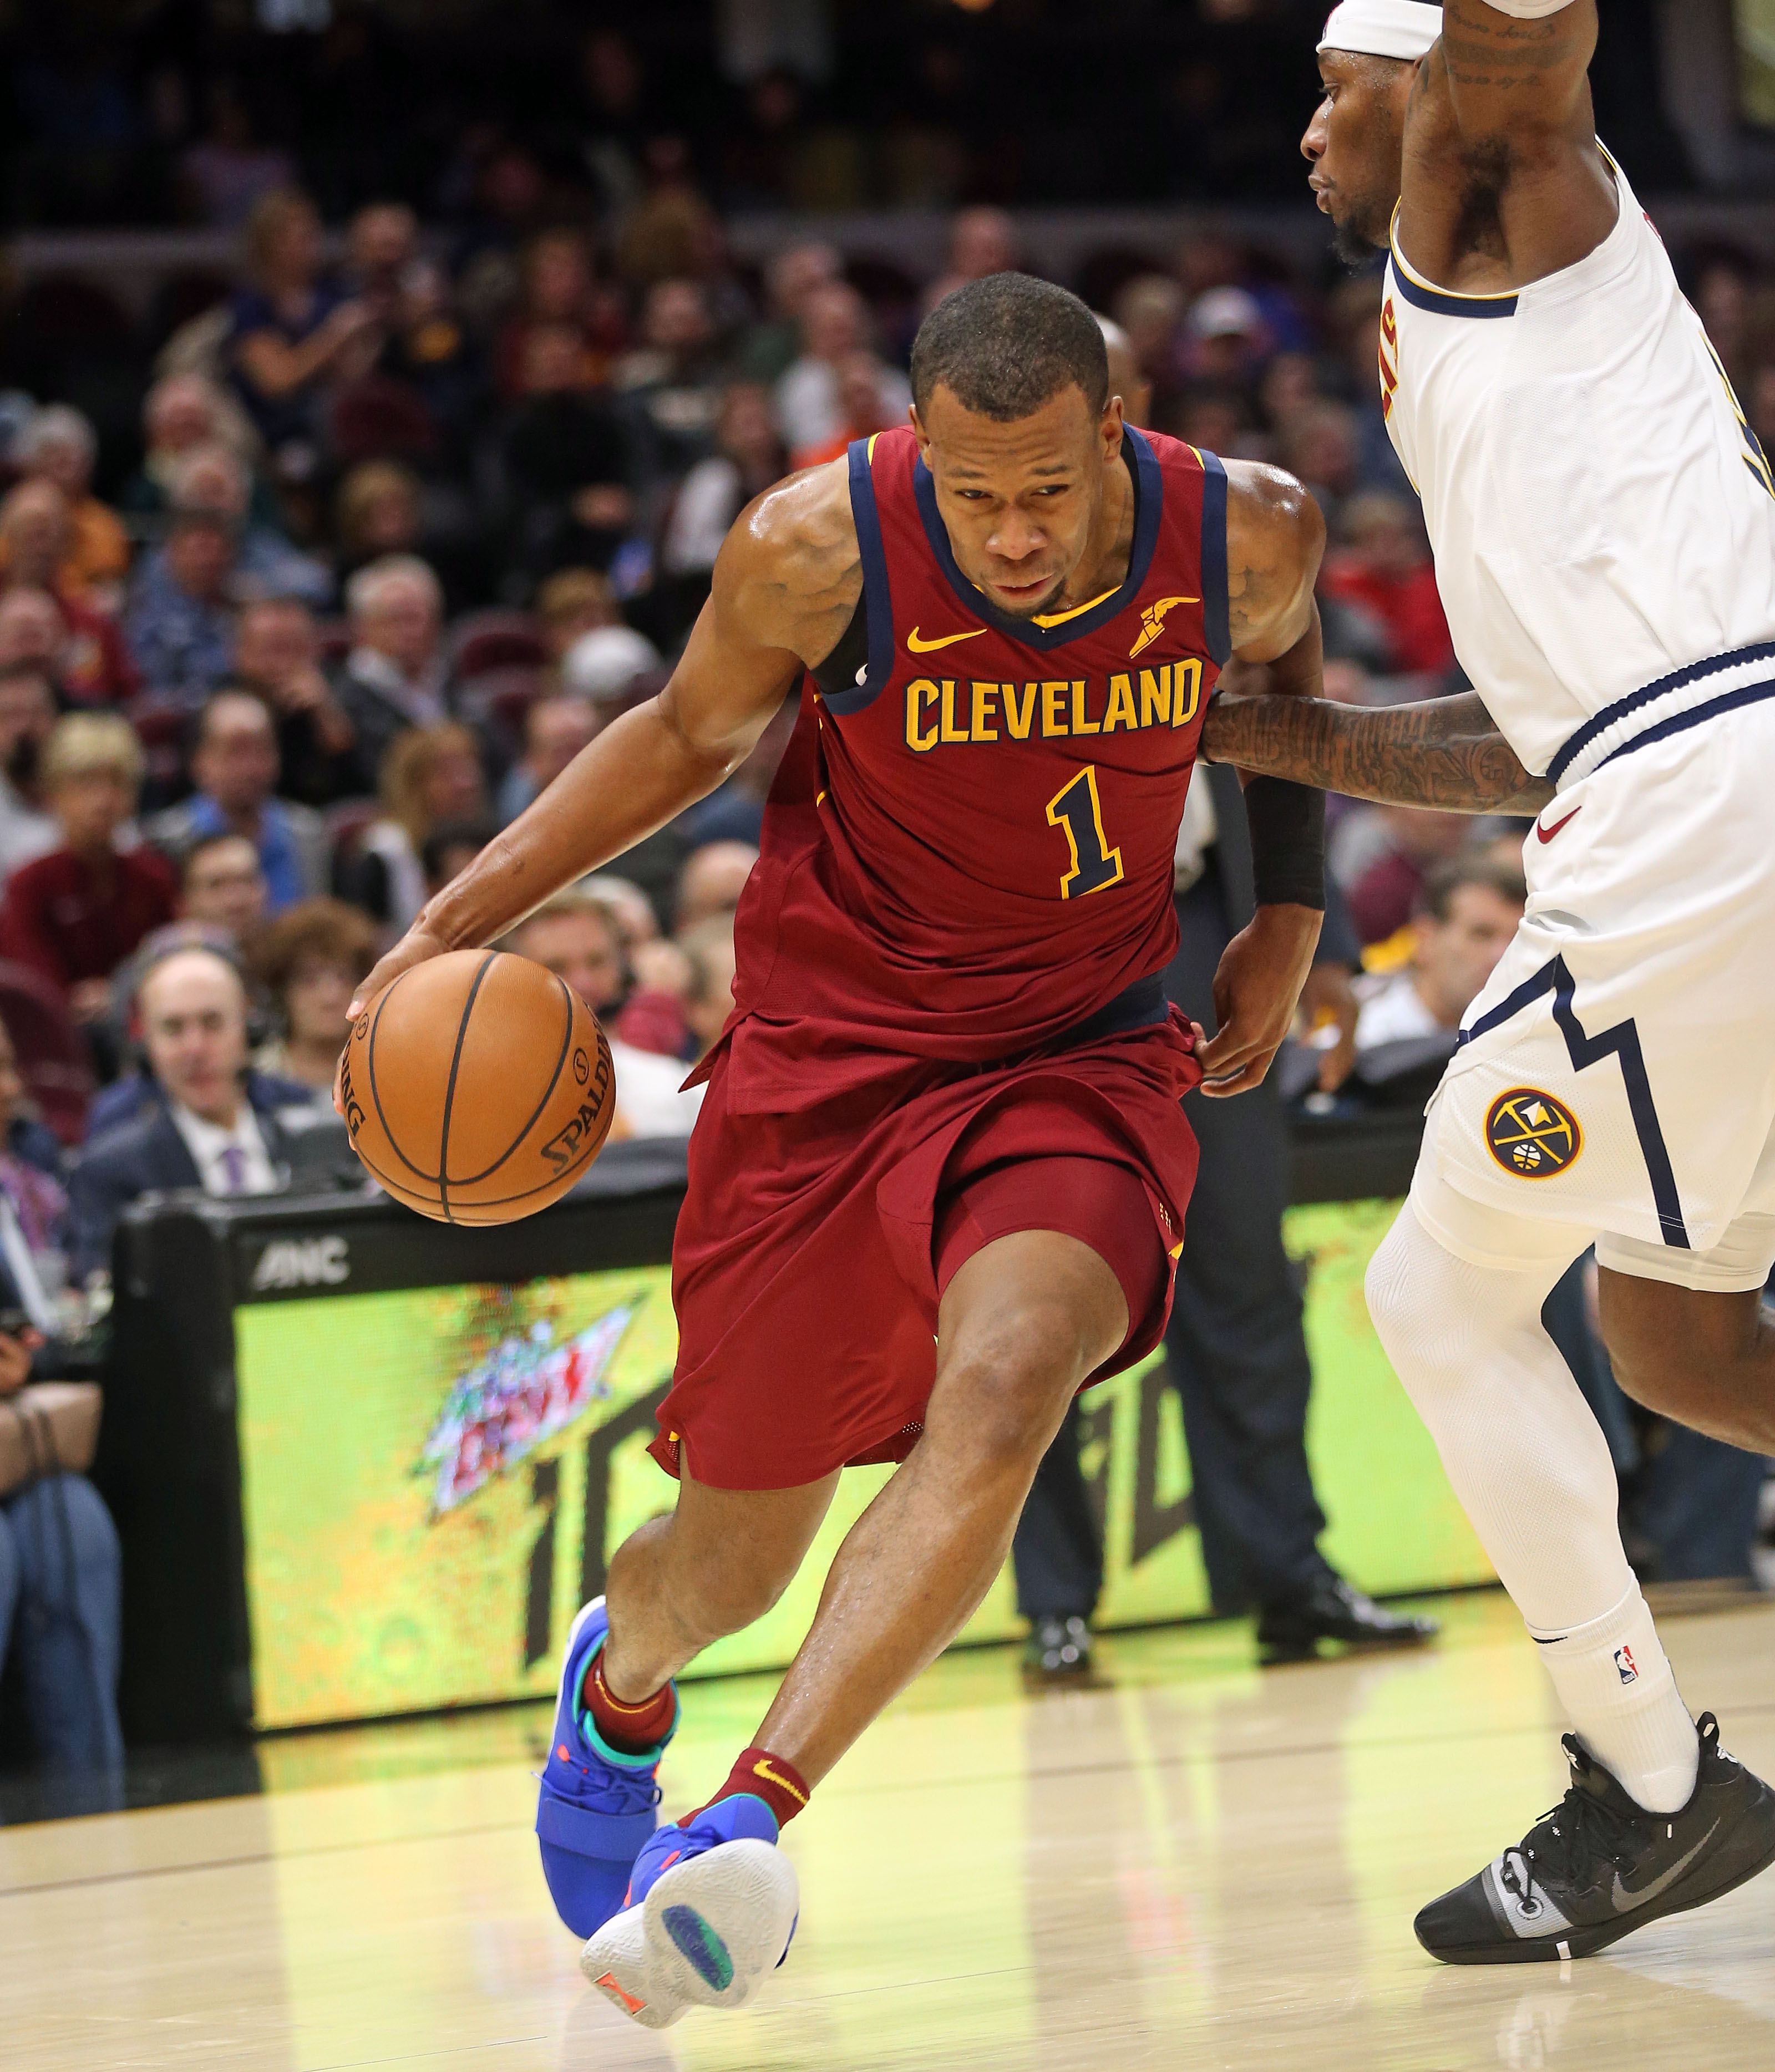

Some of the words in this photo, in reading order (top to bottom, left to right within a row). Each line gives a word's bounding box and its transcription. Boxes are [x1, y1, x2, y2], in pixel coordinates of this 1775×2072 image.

[904, 657, 1203, 752] CLEVELAND
[1046, 765, 1124, 900] 1
[252, 1236, 351, 1291] ANC
